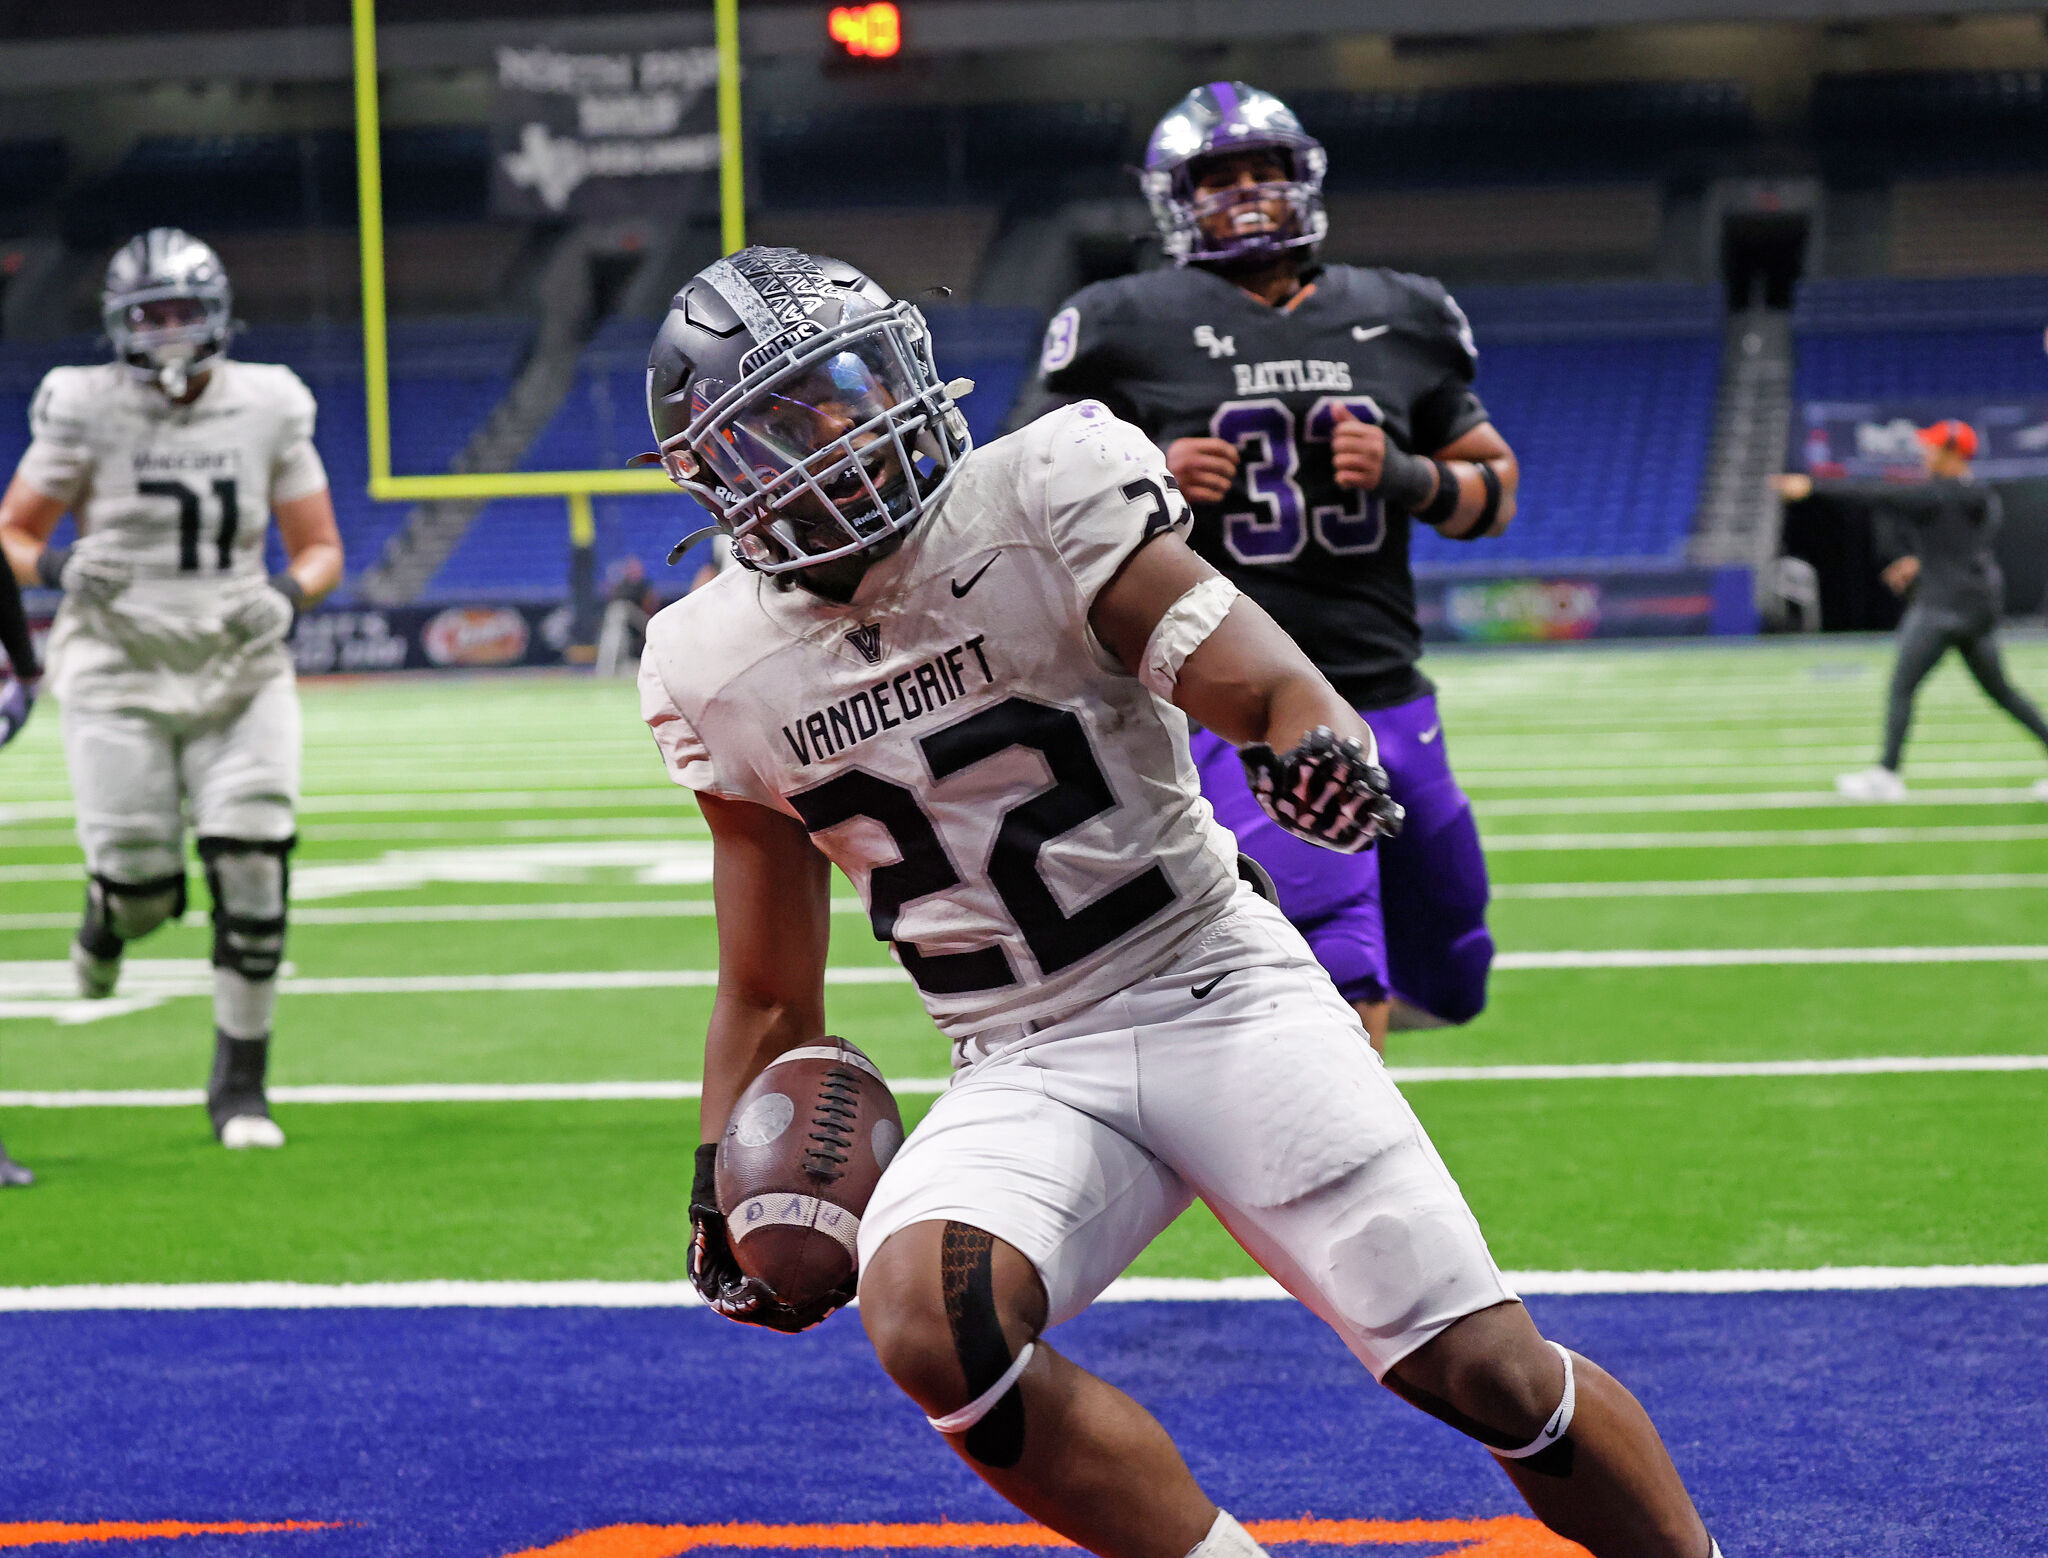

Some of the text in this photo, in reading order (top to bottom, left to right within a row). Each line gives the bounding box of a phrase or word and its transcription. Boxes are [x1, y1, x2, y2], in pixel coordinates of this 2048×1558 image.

[1233, 359, 1353, 395] RATTLERS
[137, 478, 239, 571] 71
[852, 503, 890, 527] Riddl
[1210, 396, 1386, 565] 33
[782, 634, 994, 767] VANDEGRIFT
[780, 694, 1183, 997] 22
